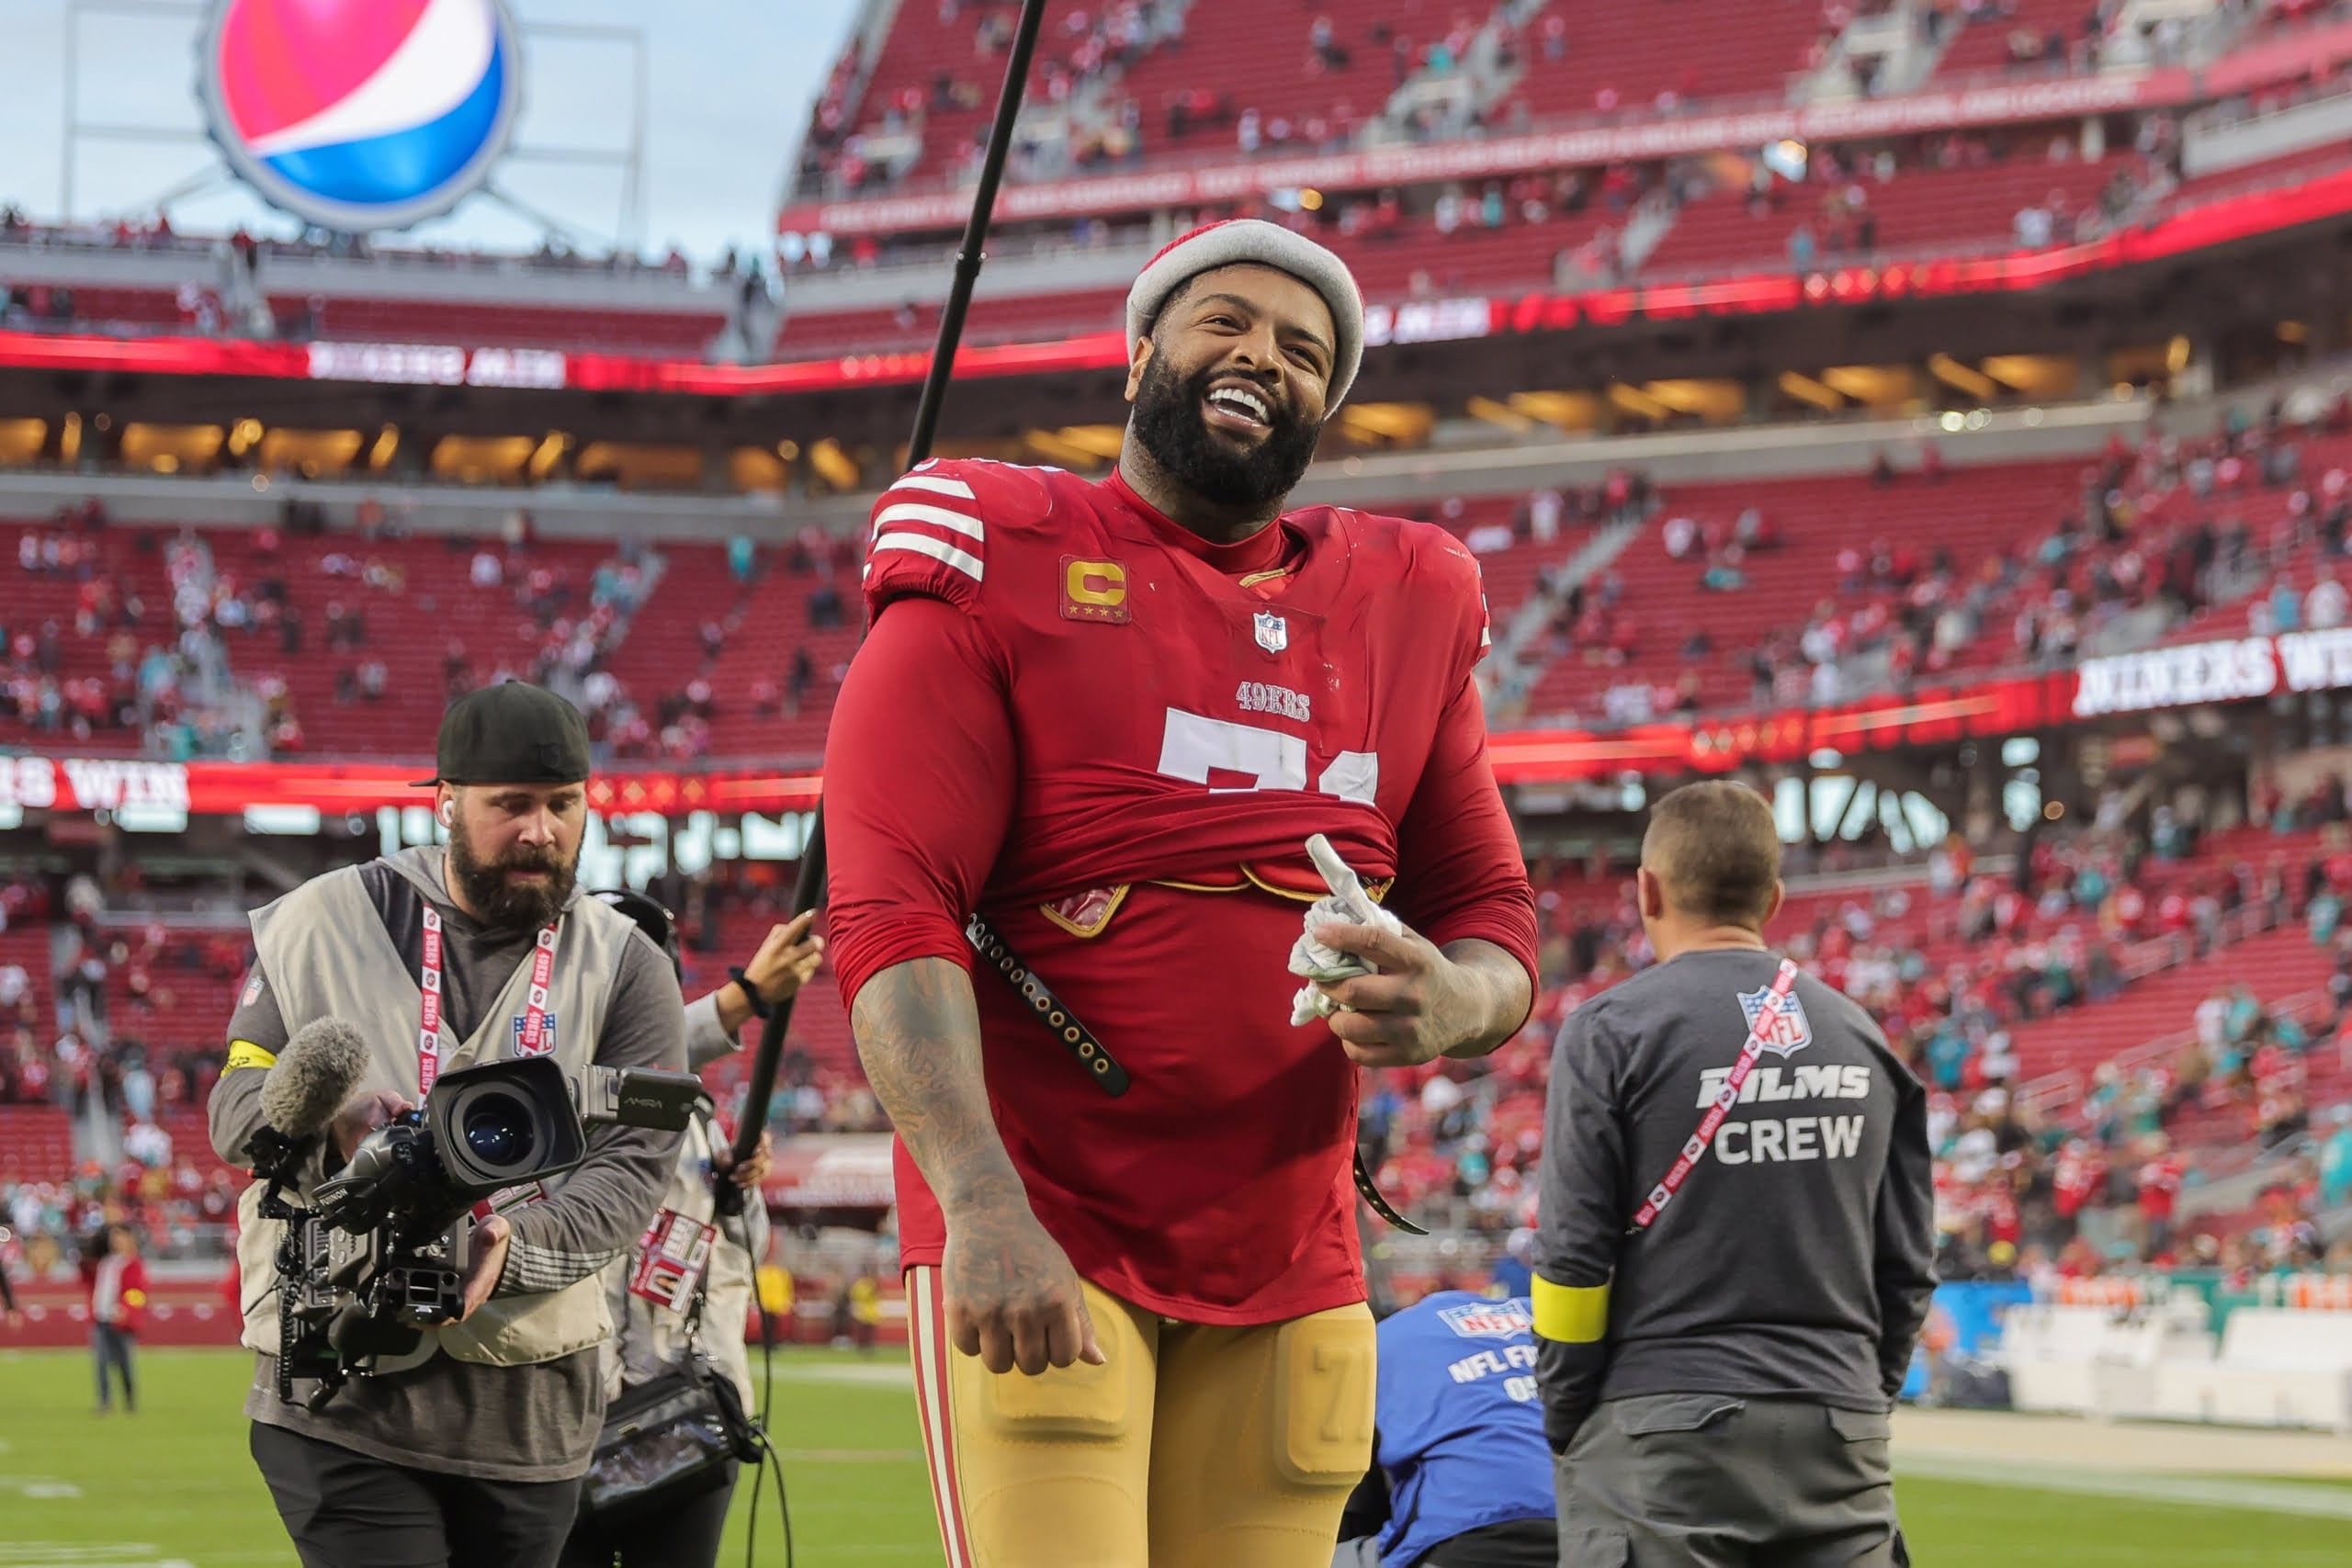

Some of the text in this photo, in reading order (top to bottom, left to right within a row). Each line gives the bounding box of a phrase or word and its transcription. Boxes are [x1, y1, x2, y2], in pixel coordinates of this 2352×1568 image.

[1067, 560, 1125, 606] C
[1260, 628, 1283, 645] NFL
[1235, 681, 1311, 722] 49ERS
[424, 933, 439, 965] 49ERS
[534, 952, 550, 984] 49ERS
[424, 994, 437, 1028] 49ERS
[525, 1011, 542, 1044] 49ERS
[1714, 1115, 1866, 1166] CREW
[1447, 1349, 1510, 1384] NFL
